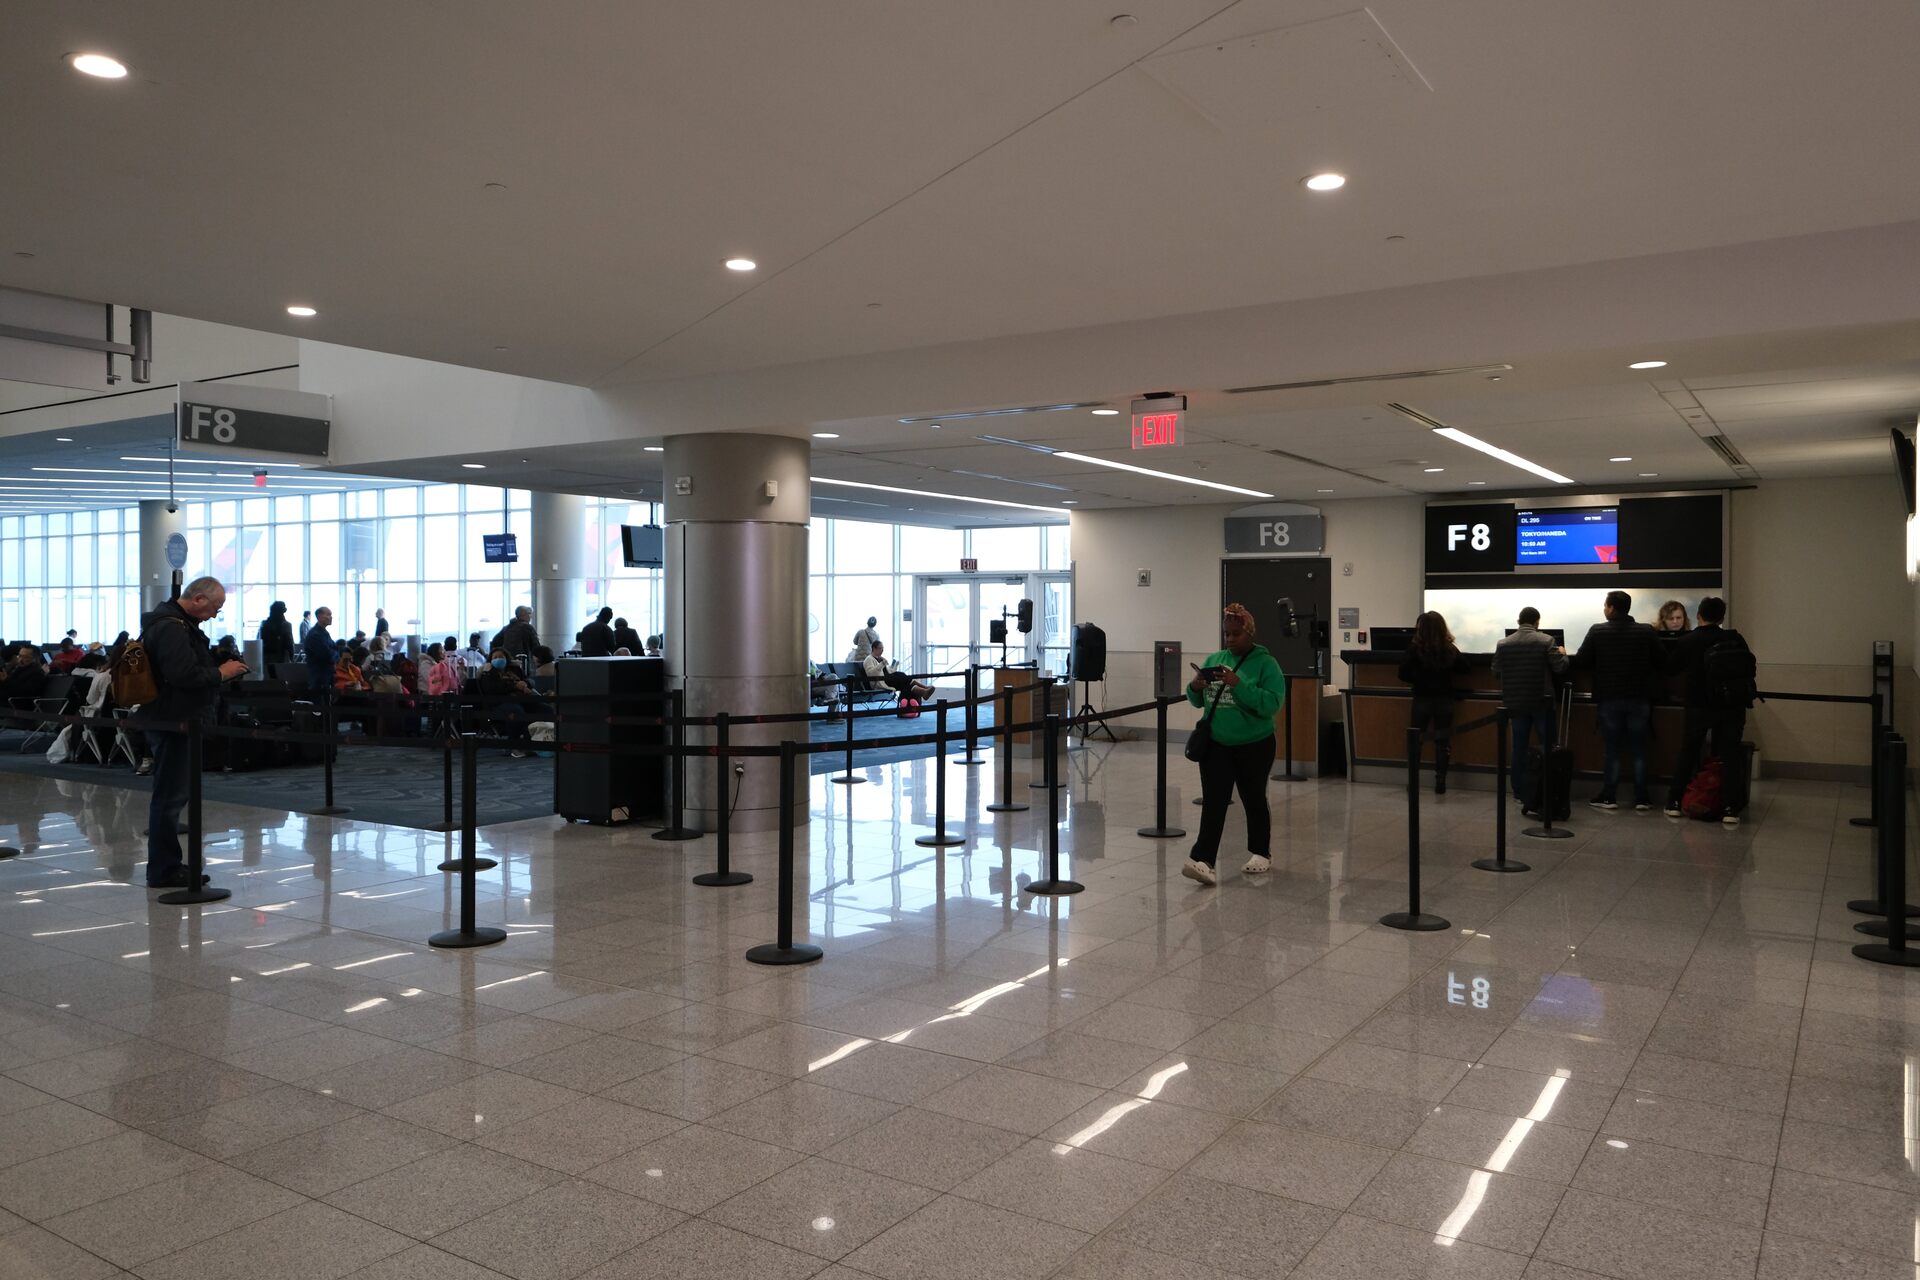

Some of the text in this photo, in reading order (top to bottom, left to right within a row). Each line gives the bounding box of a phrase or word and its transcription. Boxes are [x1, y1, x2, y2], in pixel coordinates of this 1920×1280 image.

[191, 405, 237, 443] F8
[1143, 414, 1177, 446] EXIT
[1260, 522, 1290, 546] F8
[1448, 523, 1491, 551] F8
